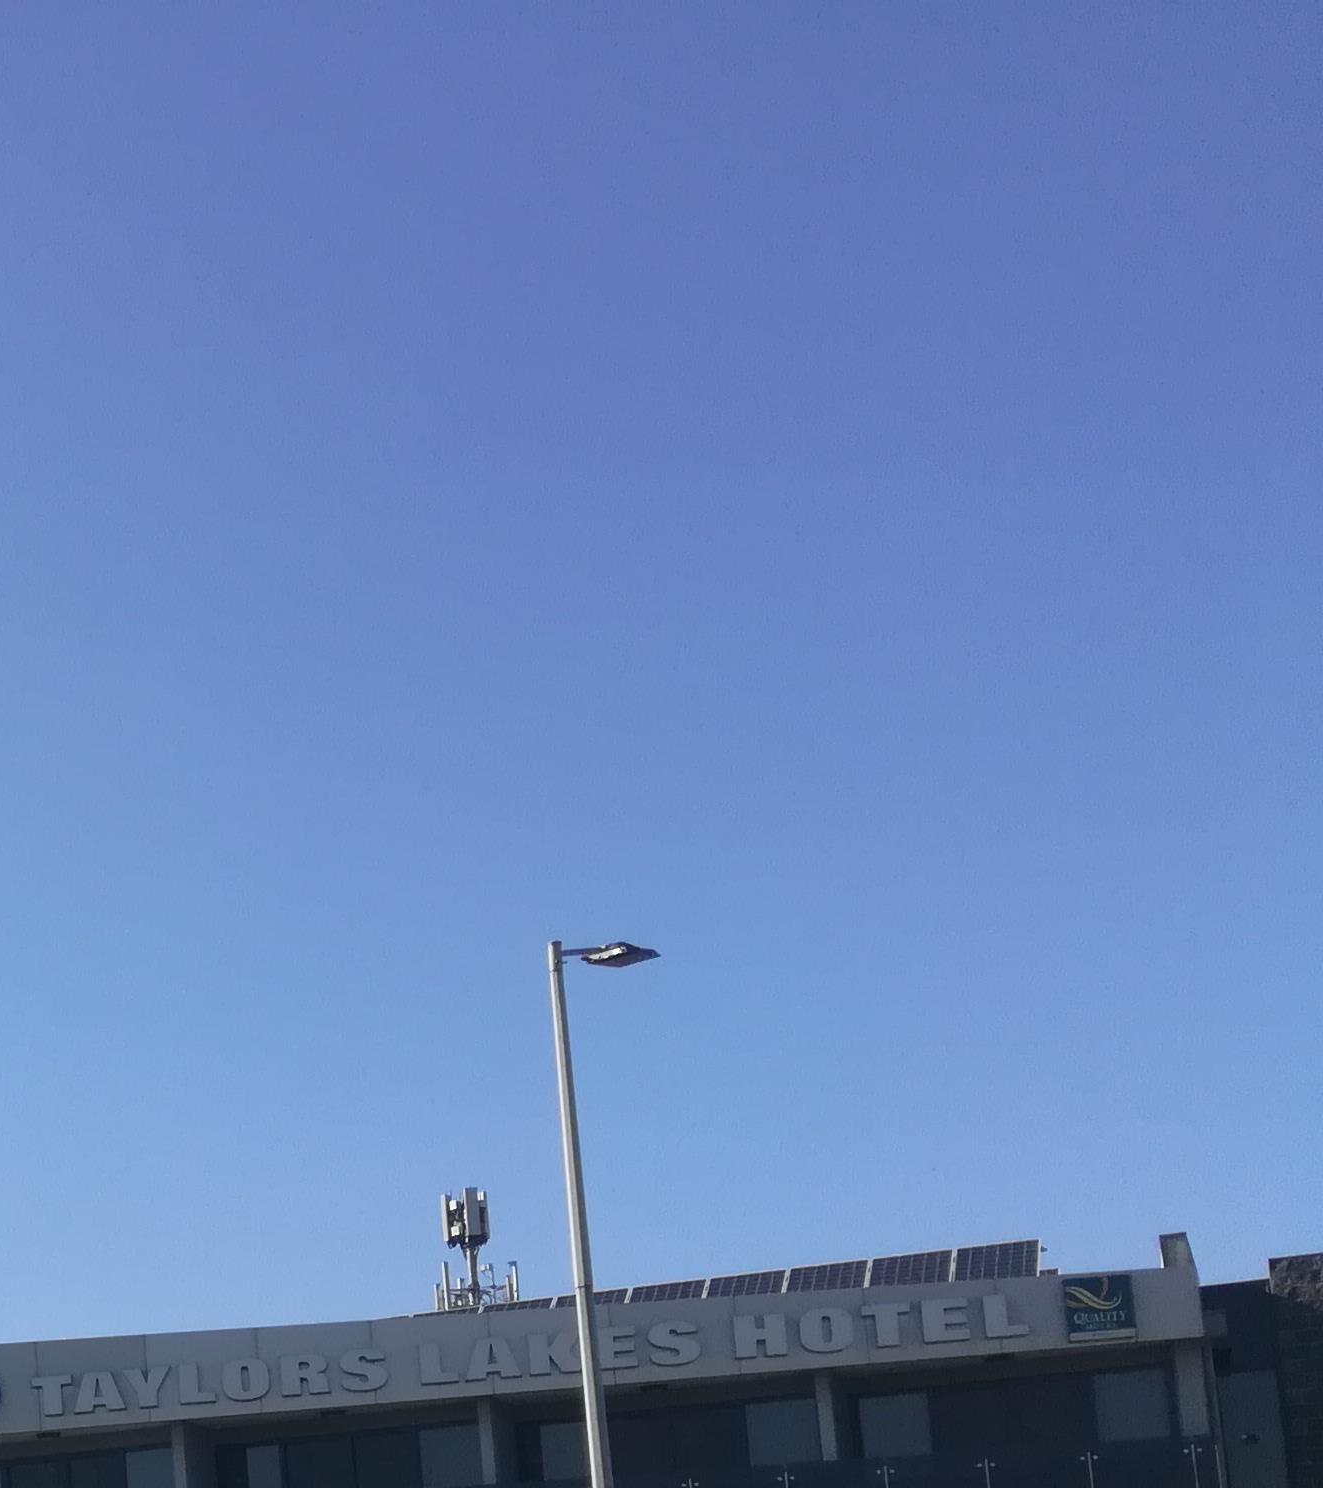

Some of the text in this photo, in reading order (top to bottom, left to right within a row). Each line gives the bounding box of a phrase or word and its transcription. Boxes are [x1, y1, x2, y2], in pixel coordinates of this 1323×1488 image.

[1073, 1310, 1127, 1325] QUALITY
[31, 1293, 1030, 1416] TAYLORS LAKES HOTEL
